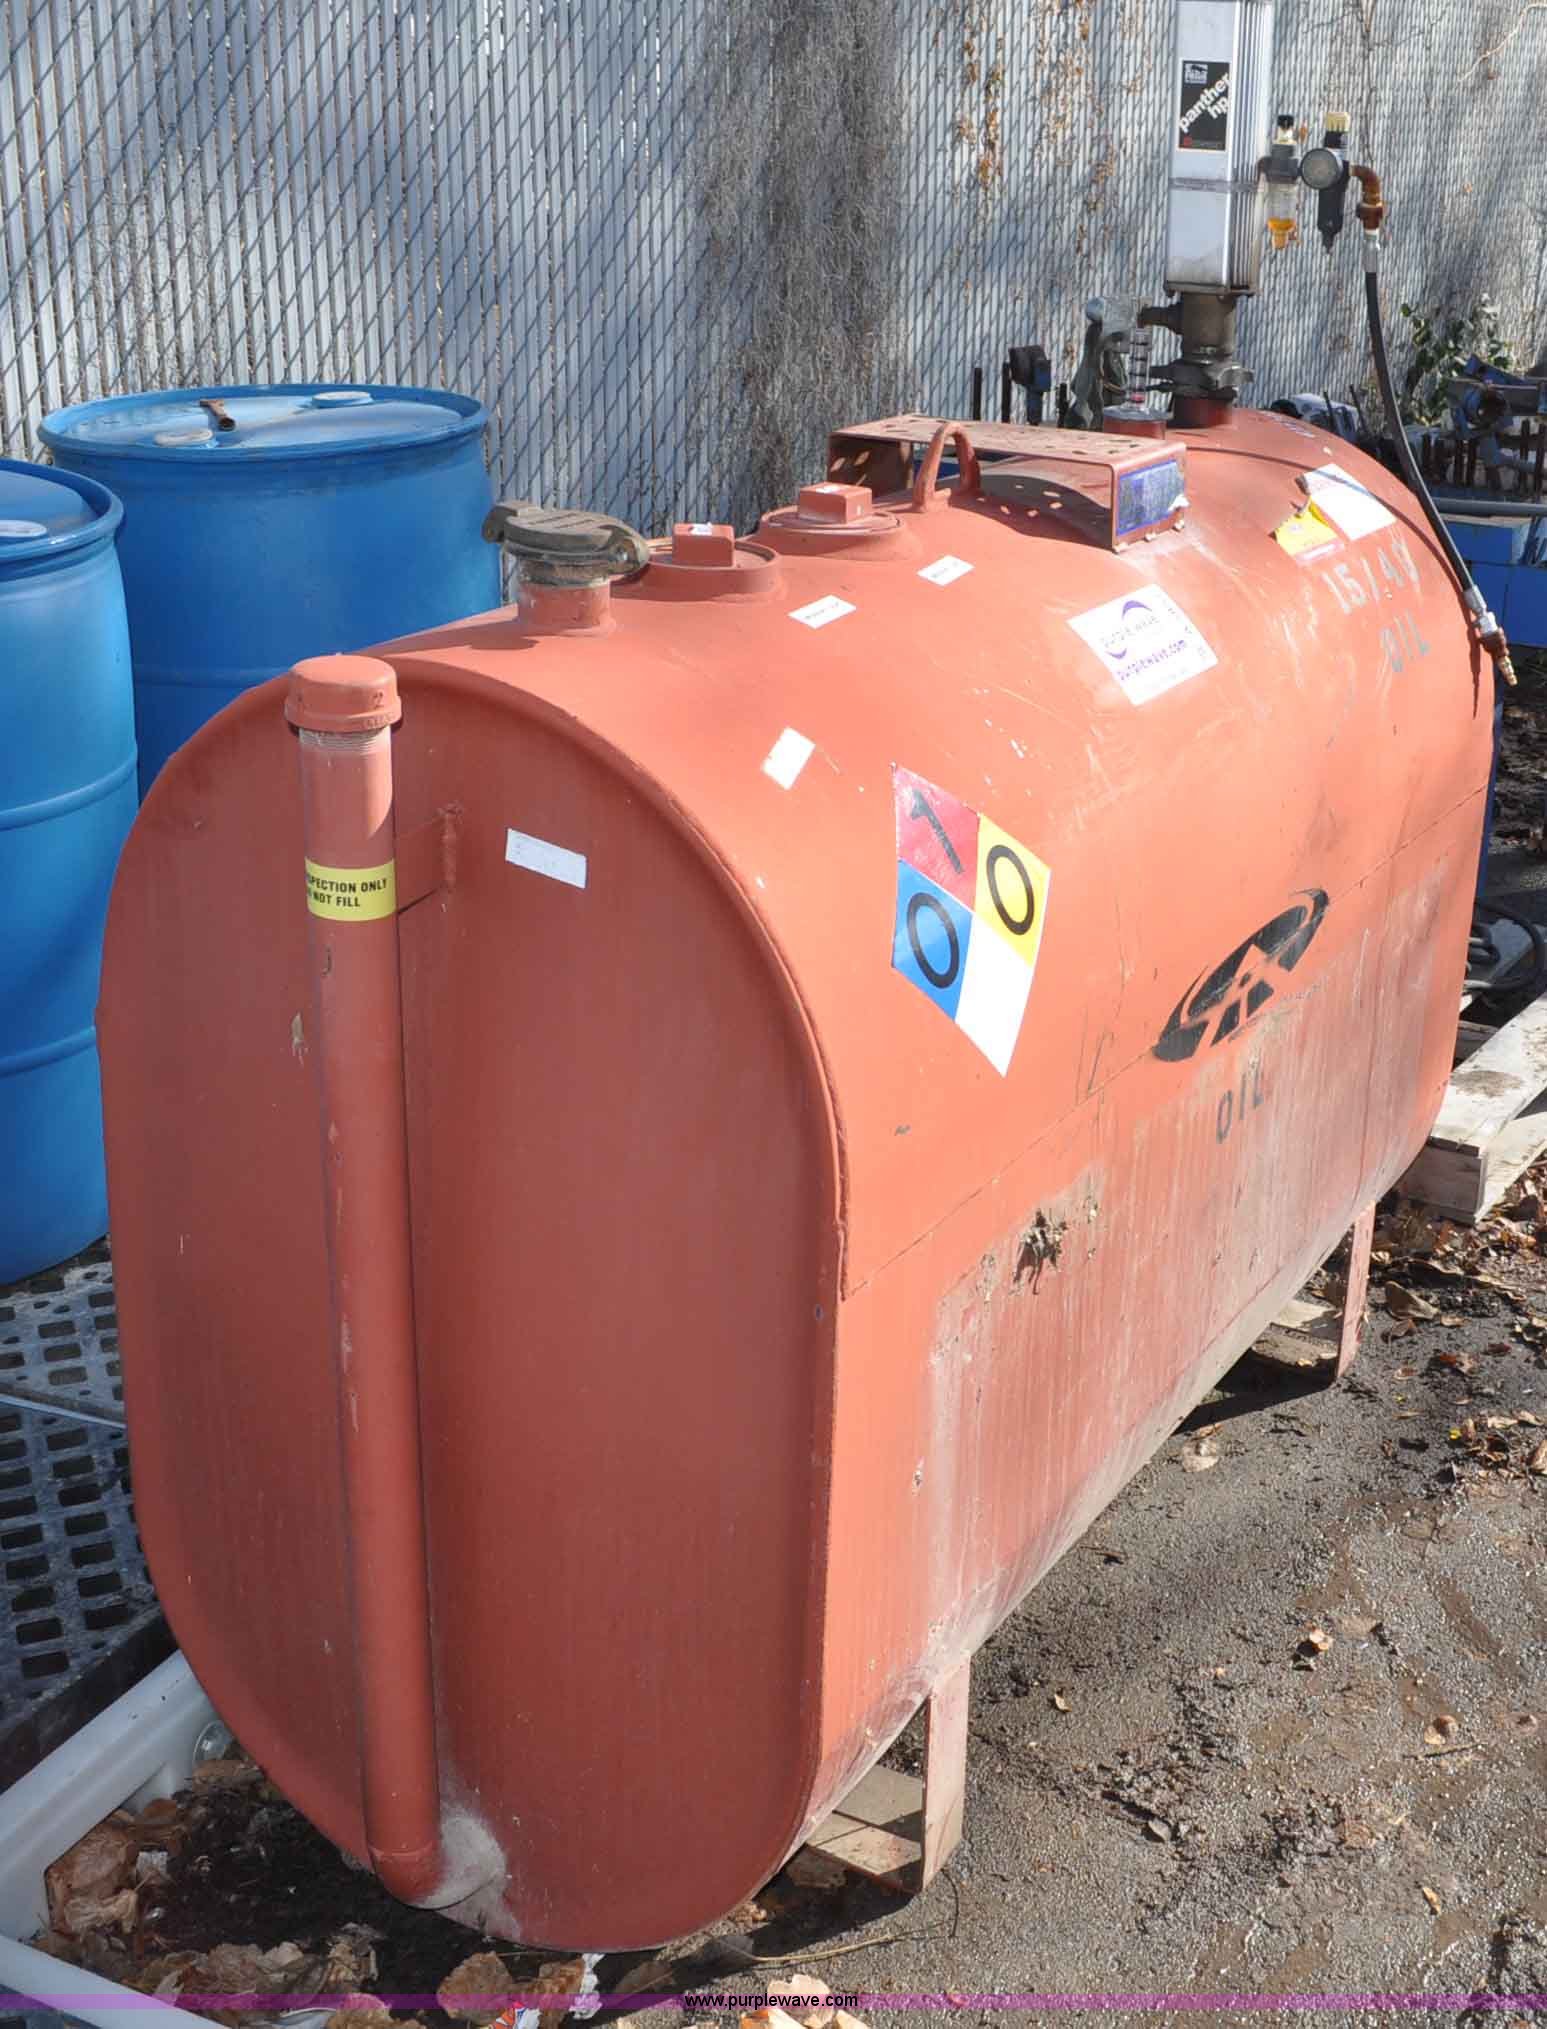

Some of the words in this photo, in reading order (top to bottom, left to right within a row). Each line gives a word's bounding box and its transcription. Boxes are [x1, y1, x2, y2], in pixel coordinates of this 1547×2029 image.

[1179, 72, 1232, 134] panther
[910, 789, 964, 875] 1
[313, 891, 332, 904] NOT
[336, 896, 360, 907] FILL
[361, 878, 387, 892] ONLY
[986, 844, 1034, 935] 0
[907, 892, 959, 989] 0
[1216, 1064, 1263, 1144] OIL
